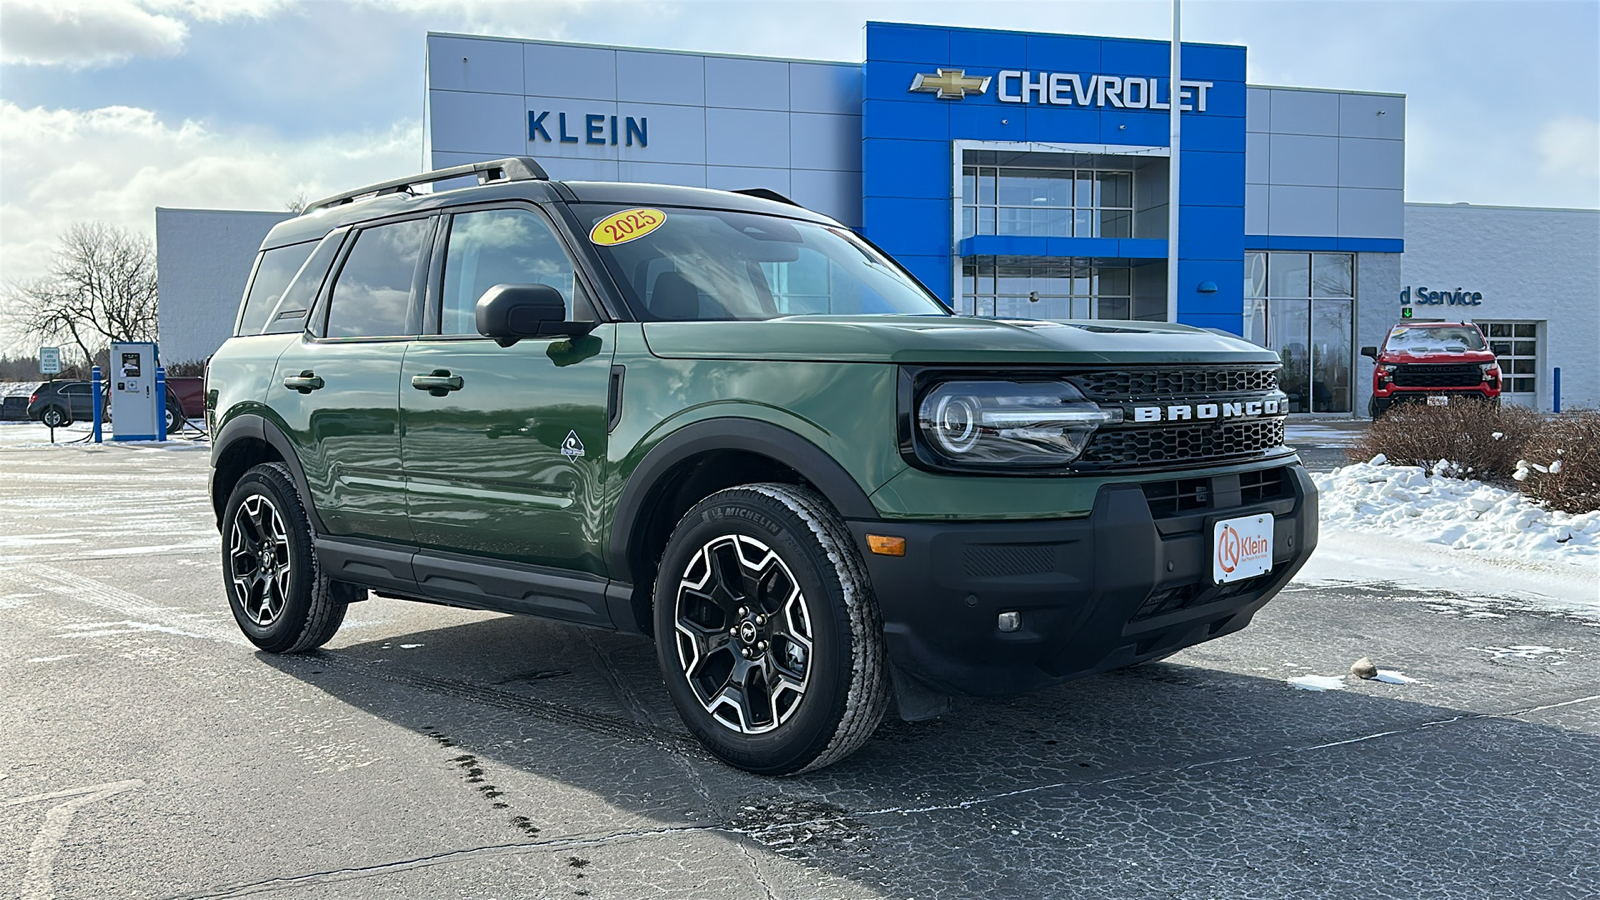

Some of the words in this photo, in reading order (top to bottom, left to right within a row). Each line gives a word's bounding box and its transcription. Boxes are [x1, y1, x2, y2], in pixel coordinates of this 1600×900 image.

[998, 70, 1214, 112] CHEVROLET
[528, 110, 648, 147] KLEIN
[603, 210, 657, 241] 2025
[1416, 287, 1482, 306] Service
[1134, 400, 1279, 422] BRONCO
[725, 507, 780, 533] MICHELIN
[1241, 535, 1268, 557] Klein
